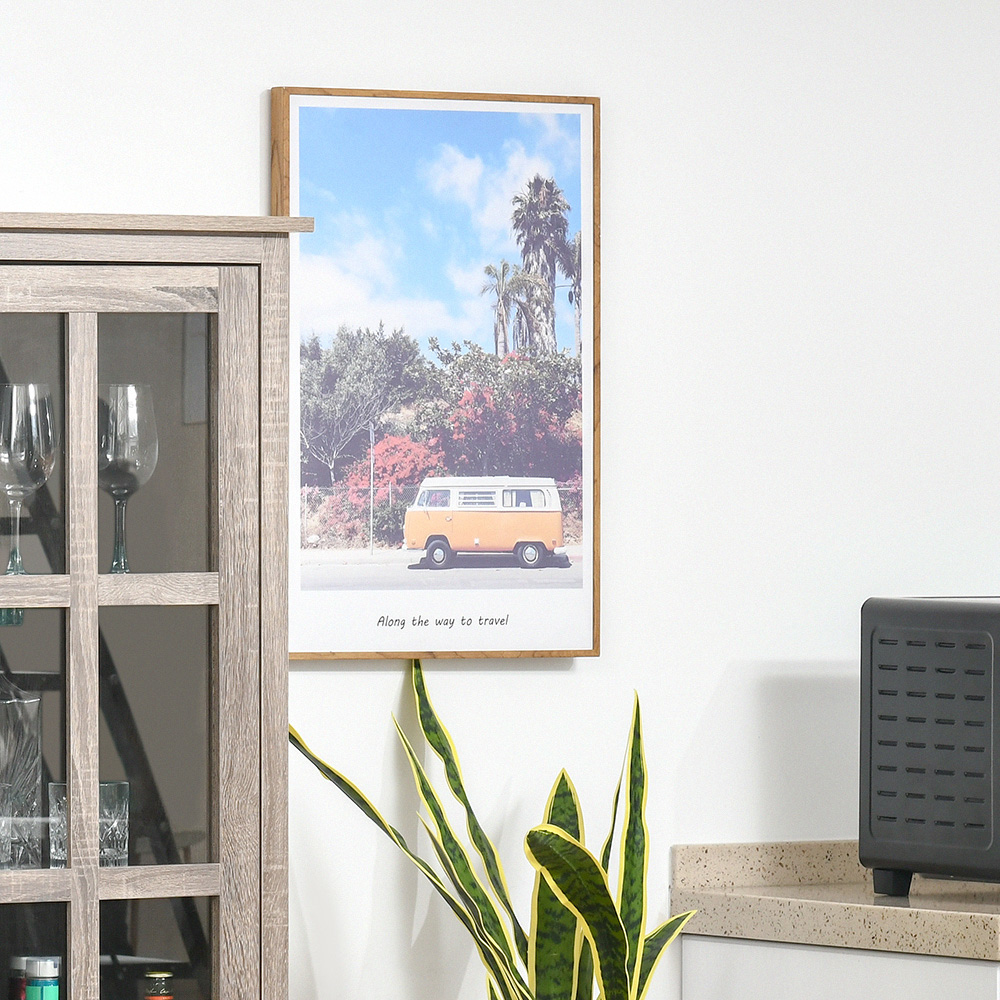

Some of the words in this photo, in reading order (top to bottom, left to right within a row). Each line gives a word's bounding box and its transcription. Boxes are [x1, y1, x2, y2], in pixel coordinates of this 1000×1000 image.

[377, 615, 406, 629] Along
[411, 615, 430, 627] the
[435, 618, 455, 629] way
[460, 616, 473, 626] to
[478, 614, 510, 626] travel
